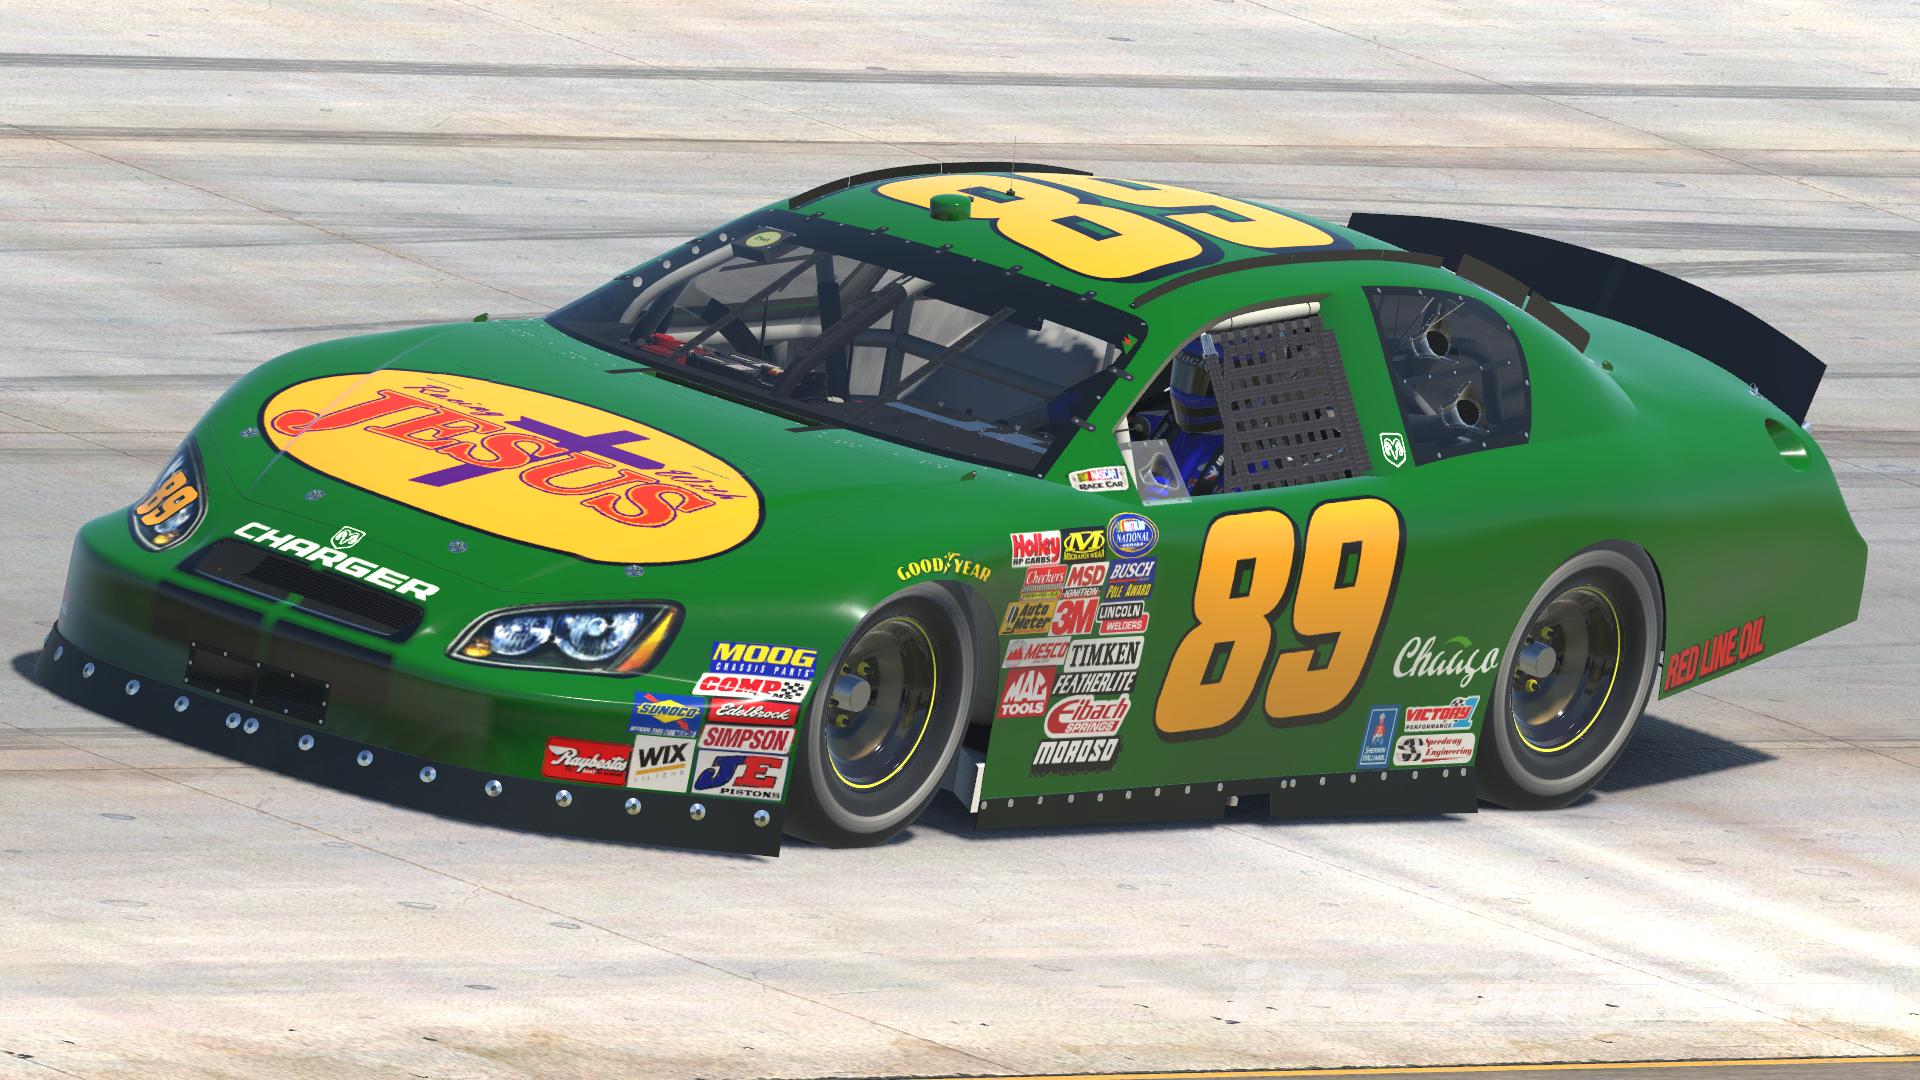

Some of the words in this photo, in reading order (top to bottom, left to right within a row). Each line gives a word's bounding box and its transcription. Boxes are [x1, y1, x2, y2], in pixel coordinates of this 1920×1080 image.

[873, 172, 1345, 281] 89
[403, 385, 505, 417] Racing
[271, 389, 717, 529] JESUS
[655, 470, 748, 500] With
[1079, 482, 1104, 491] RACE
[1106, 480, 1124, 489] CAR
[136, 469, 200, 527] 89
[1012, 534, 1060, 563] Holley
[233, 521, 441, 602] CHARGER
[1013, 557, 1024, 565] HP
[1025, 556, 1051, 565] CARBS
[1026, 569, 1065, 586] Checkers
[1067, 564, 1106, 587] MSD
[1110, 561, 1155, 580] BUSCH
[1063, 587, 1099, 599] IGNITION
[1106, 585, 1124, 600] POLE
[1125, 583, 1152, 598] AWARD
[1020, 603, 1050, 617] Auto
[1051, 598, 1099, 636] 3M
[1100, 605, 1142, 619] LINCOLN
[1153, 496, 1407, 743] 89
[1015, 616, 1051, 630] Meter
[1106, 620, 1142, 631] WELDERS
[712, 642, 818, 668] MOOG
[1024, 641, 1070, 660] MESCO
[1069, 641, 1141, 668] TIMKEN
[1663, 644, 1700, 692] RED
[1700, 627, 1739, 679] LINE
[1738, 617, 1765, 661] OIL
[715, 662, 766, 674] CHASSIS
[773, 666, 810, 678] PARTS
[699, 676, 783, 694] COMP
[1002, 670, 1047, 703] MAC
[1052, 670, 1138, 695] FEATHERLITE
[639, 703, 698, 717] SUNOCO
[715, 702, 792, 721] Edelbrock
[1001, 701, 1045, 716] TOOLS
[1047, 695, 1130, 734] Eibach
[1406, 706, 1473, 722] VICTORY
[1064, 720, 1116, 734] SPRINGS
[703, 726, 790, 751] SIMPSON
[1424, 737, 1463, 749] Speedway
[639, 742, 689, 768] WIX
[1032, 738, 1120, 766] MOROSO
[1425, 747, 1473, 758] Engineering
[694, 755, 784, 791] JE
[720, 787, 780, 799] PISTONS
